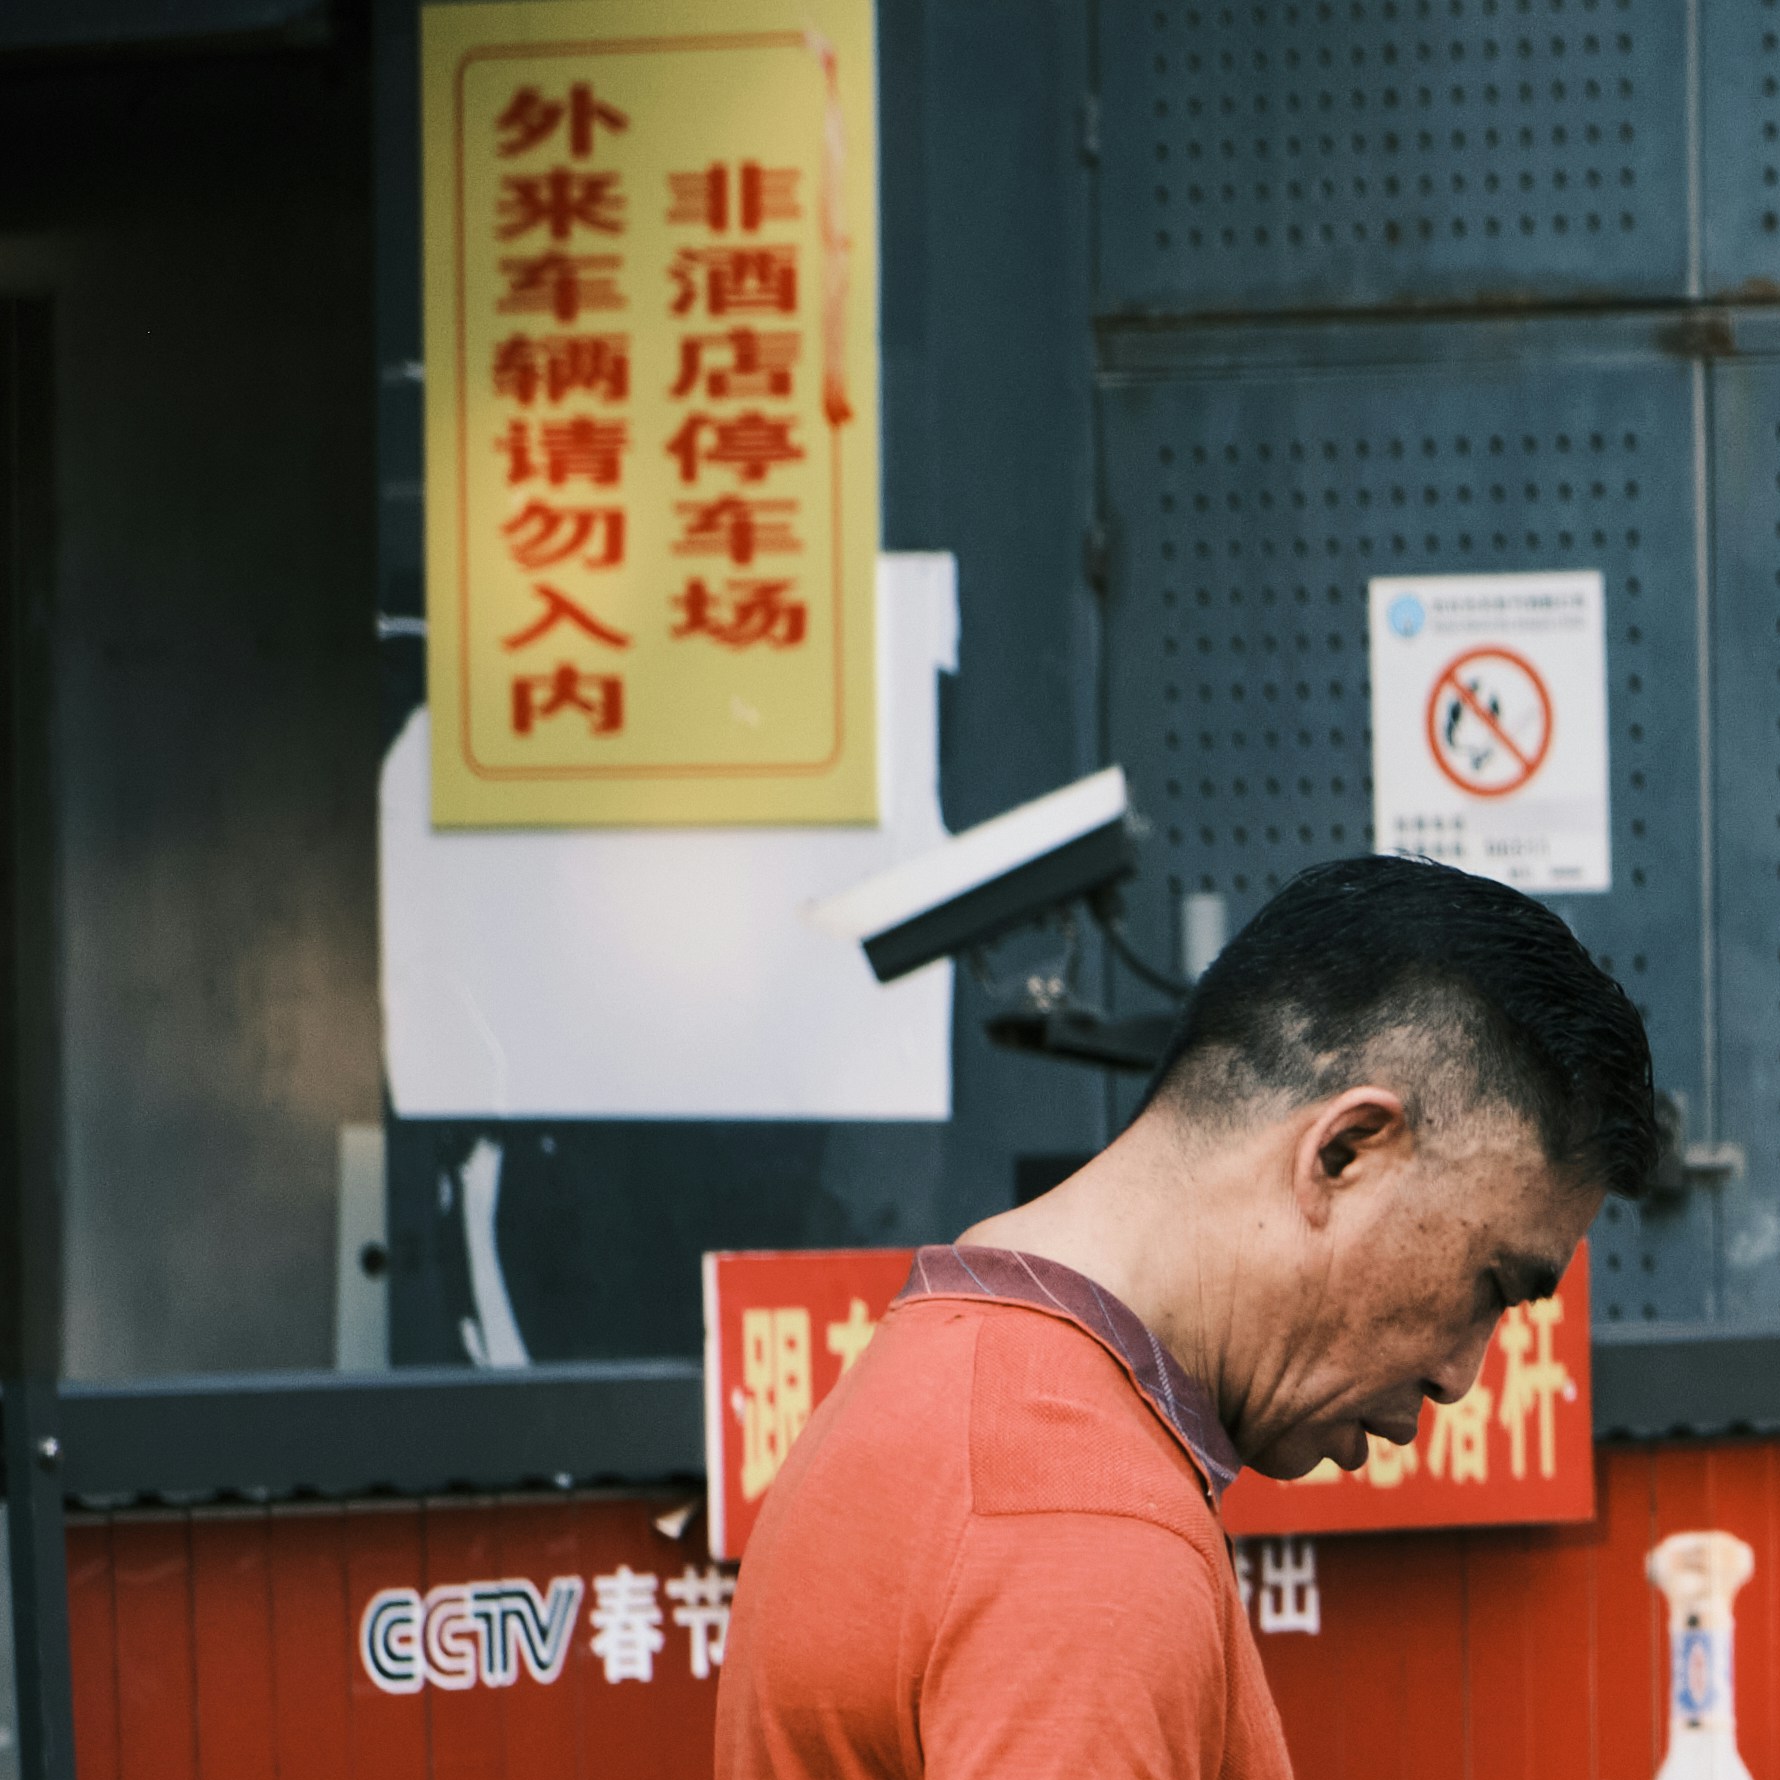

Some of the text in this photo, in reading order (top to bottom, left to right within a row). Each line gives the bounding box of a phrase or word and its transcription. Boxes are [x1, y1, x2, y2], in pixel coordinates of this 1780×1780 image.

[494, 81, 630, 740] 外来车辆请勿入内
[665, 160, 807, 652] 非酒店停车场
[361, 1577, 582, 1694] CCTV
